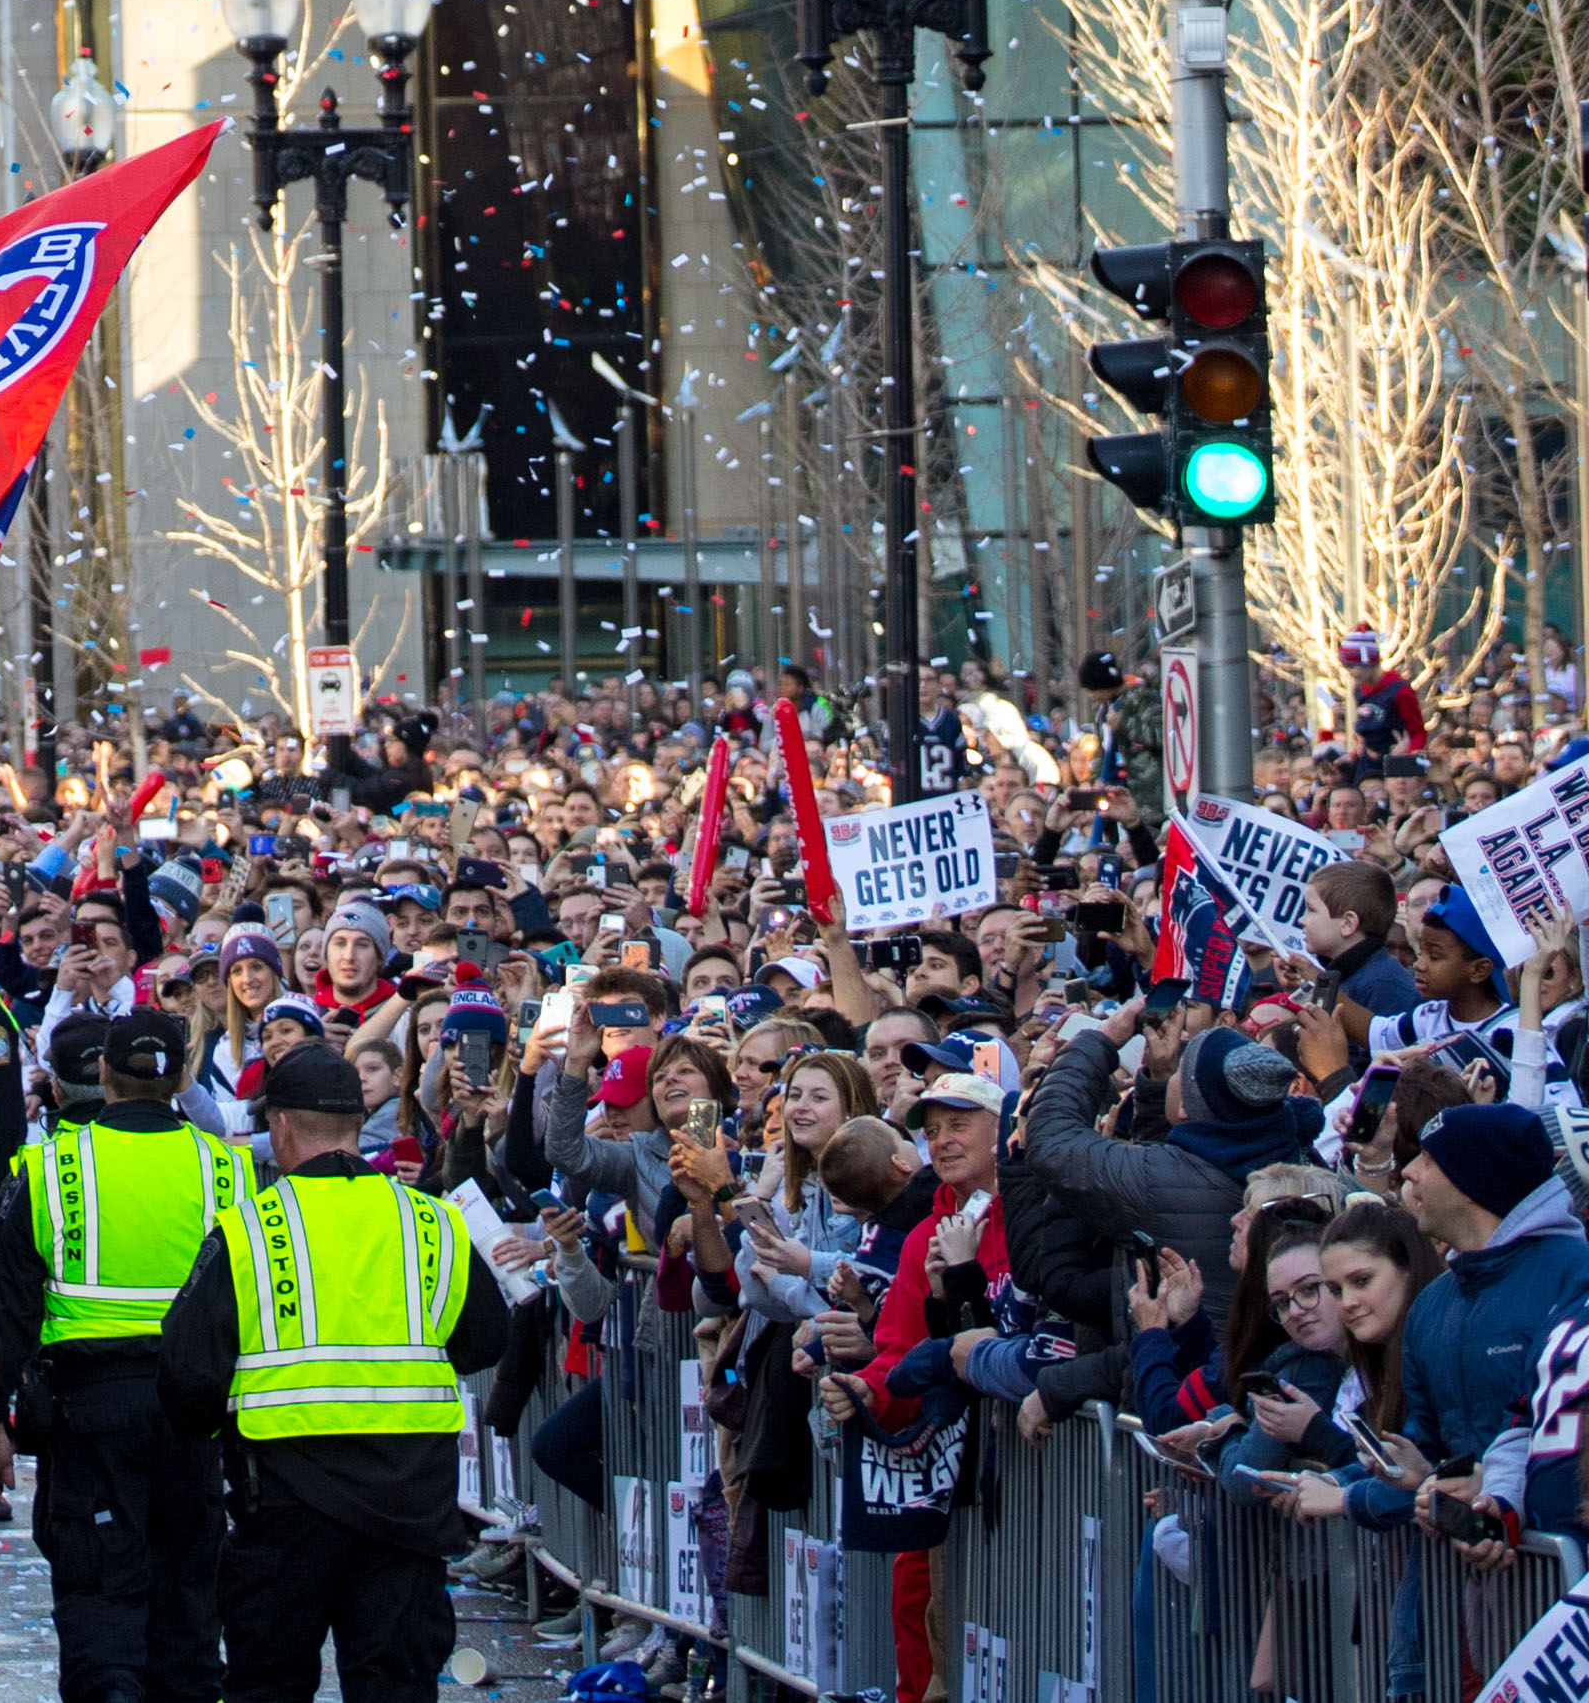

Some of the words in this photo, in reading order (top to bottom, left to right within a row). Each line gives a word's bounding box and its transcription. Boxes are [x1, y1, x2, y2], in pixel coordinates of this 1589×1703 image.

[868, 809, 958, 865] NEVER
[855, 858, 927, 906] GETS
[935, 848, 980, 893] OLD
[1199, 930, 1235, 999] SUPER
[60, 1154, 82, 1261] BOSTON
[262, 1201, 297, 1318] BOSTON
[861, 1462, 924, 1504] WE
[866, 1506, 901, 1515] 02.03.19
